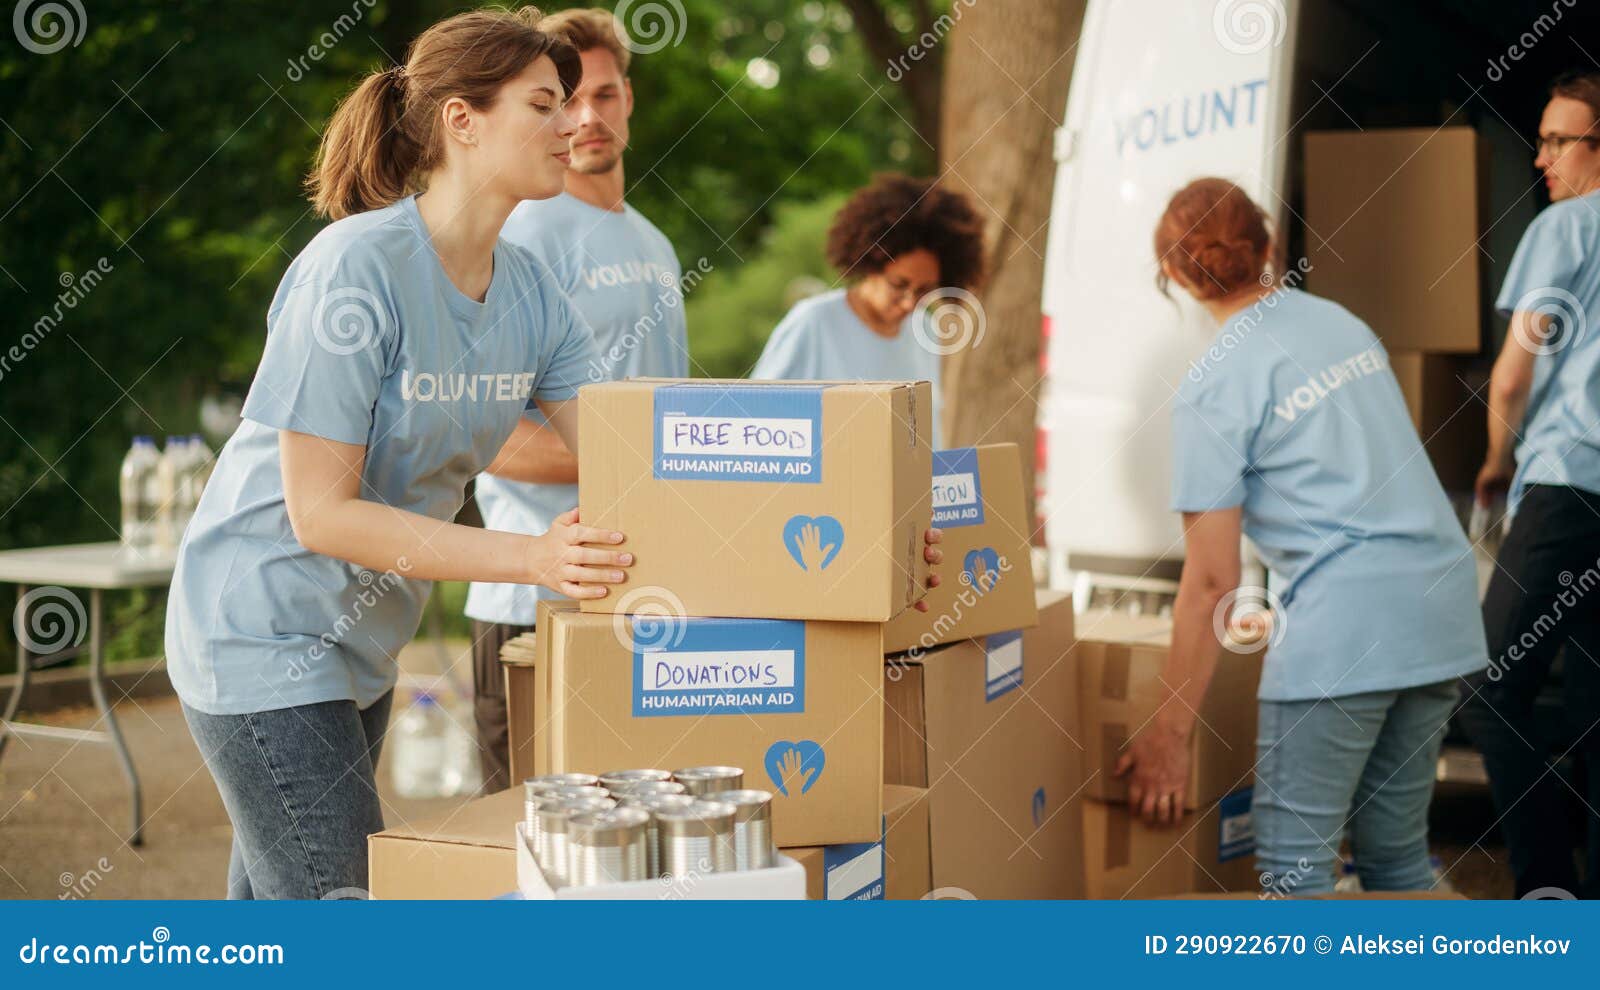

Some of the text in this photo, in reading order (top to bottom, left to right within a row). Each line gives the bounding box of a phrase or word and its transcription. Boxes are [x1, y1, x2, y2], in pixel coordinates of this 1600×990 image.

[674, 423, 806, 449] FREE FOOD
[662, 459, 812, 475] HUMANITARIAN AID
[961, 508, 978, 519] AID
[642, 692, 795, 709] HUMANITARIAN AID
